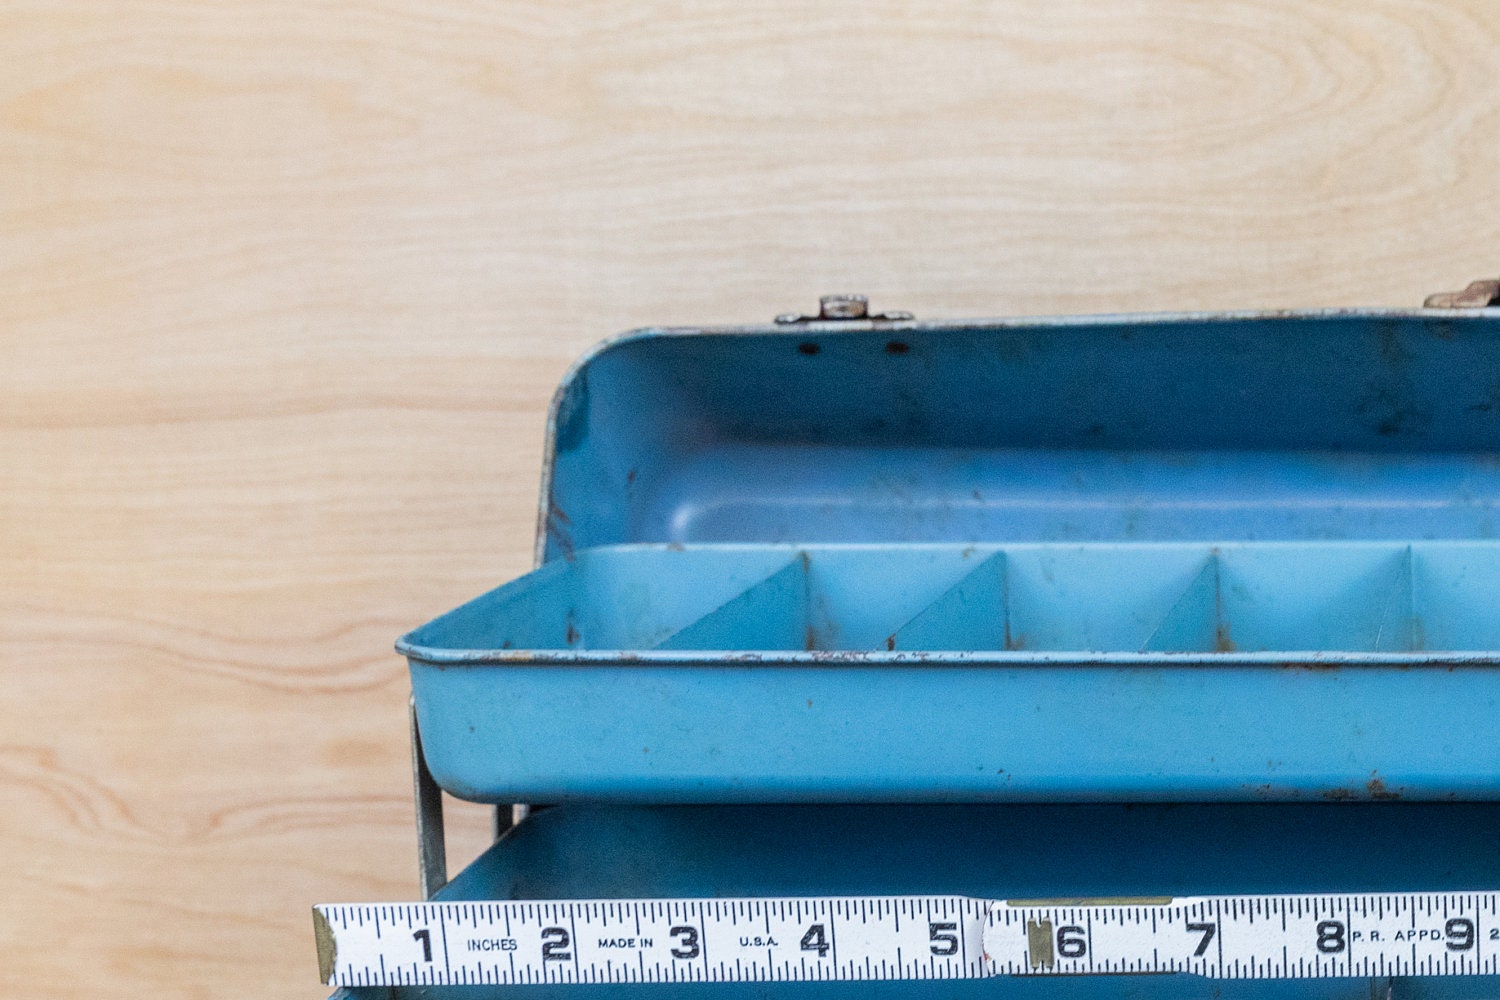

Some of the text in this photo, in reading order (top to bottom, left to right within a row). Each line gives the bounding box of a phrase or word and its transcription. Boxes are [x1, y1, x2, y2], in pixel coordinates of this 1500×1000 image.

[413, 929, 433, 962] 1
[467, 938, 517, 951] INCHES
[541, 927, 571, 961] 2
[598, 937, 635, 949] MADE
[639, 937, 653, 948] IN
[669, 926, 700, 959] 3
[739, 936, 779, 947] U.S.A.
[800, 924, 830, 957] 4
[929, 923, 959, 956] 5
[1056, 926, 1086, 958] 6
[1185, 922, 1216, 957] 7
[1315, 920, 1346, 954] 8
[1445, 918, 1474, 951] 9
